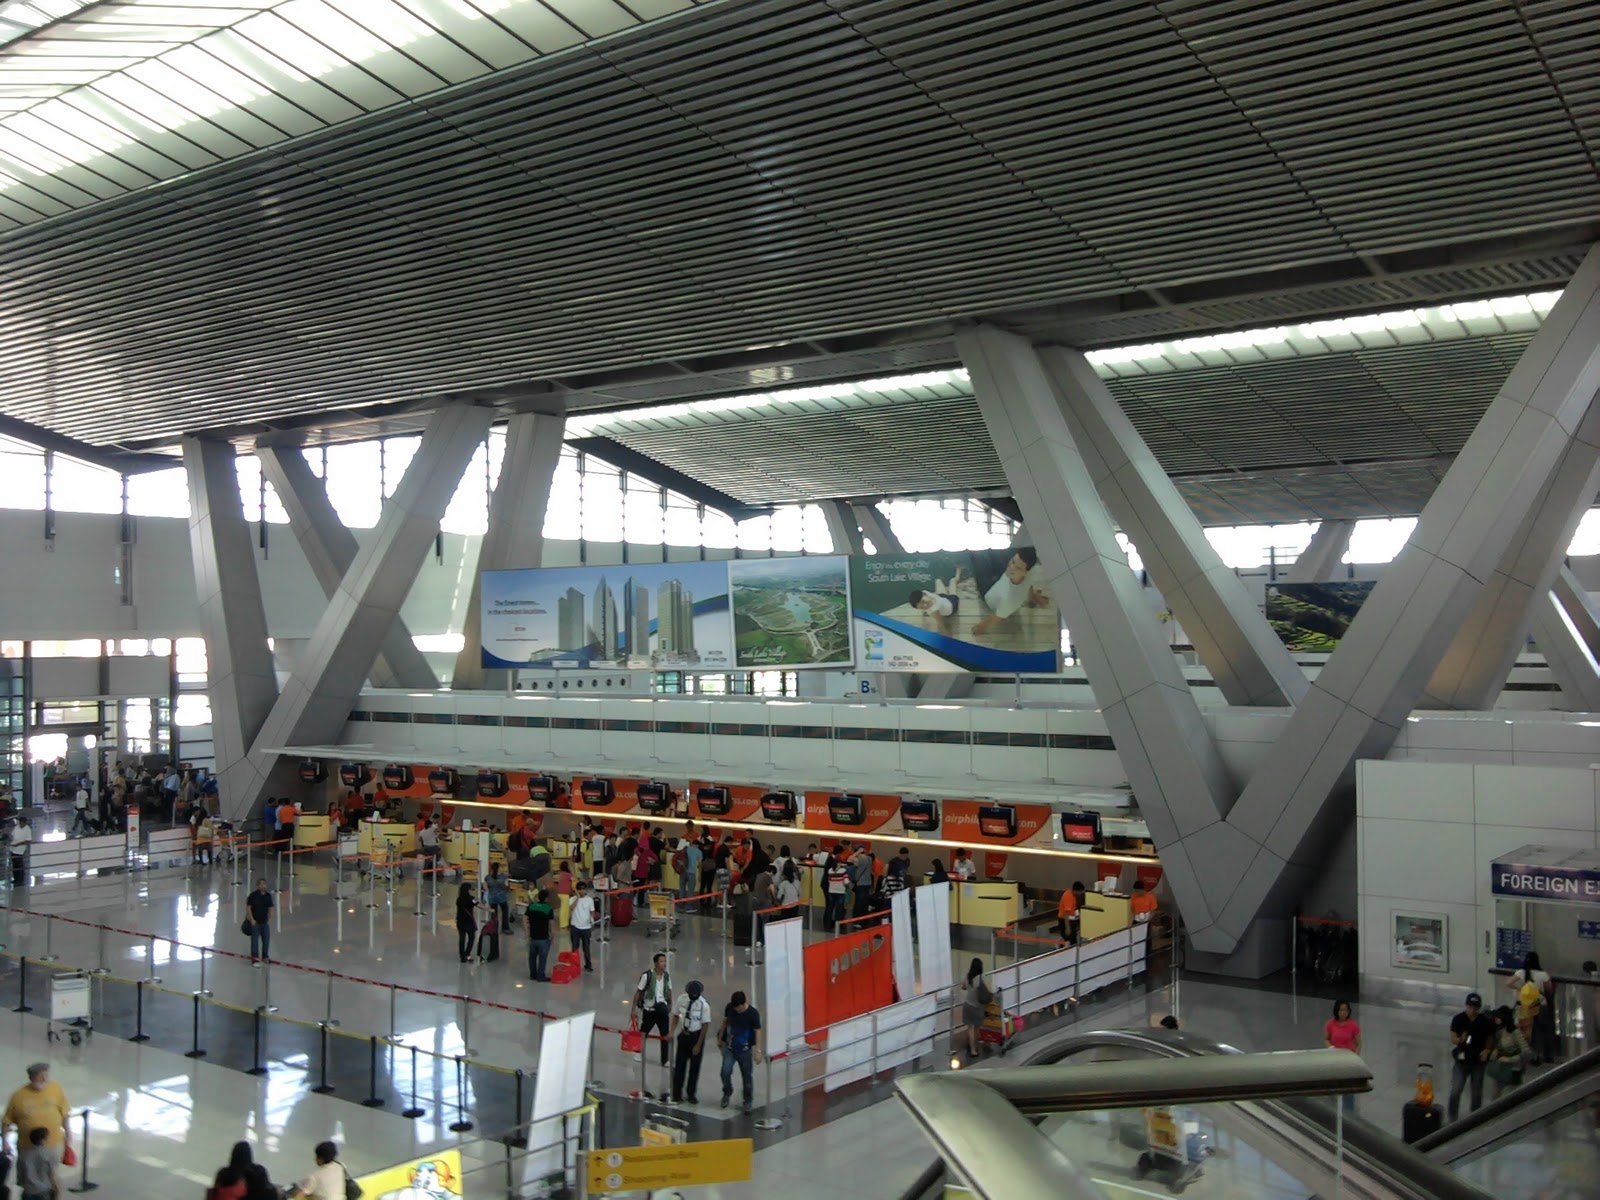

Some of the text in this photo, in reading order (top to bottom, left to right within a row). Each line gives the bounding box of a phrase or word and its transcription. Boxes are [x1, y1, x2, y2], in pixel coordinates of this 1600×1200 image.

[861, 680, 870, 693] B
[1501, 873, 1600, 895] FOREIGN E
